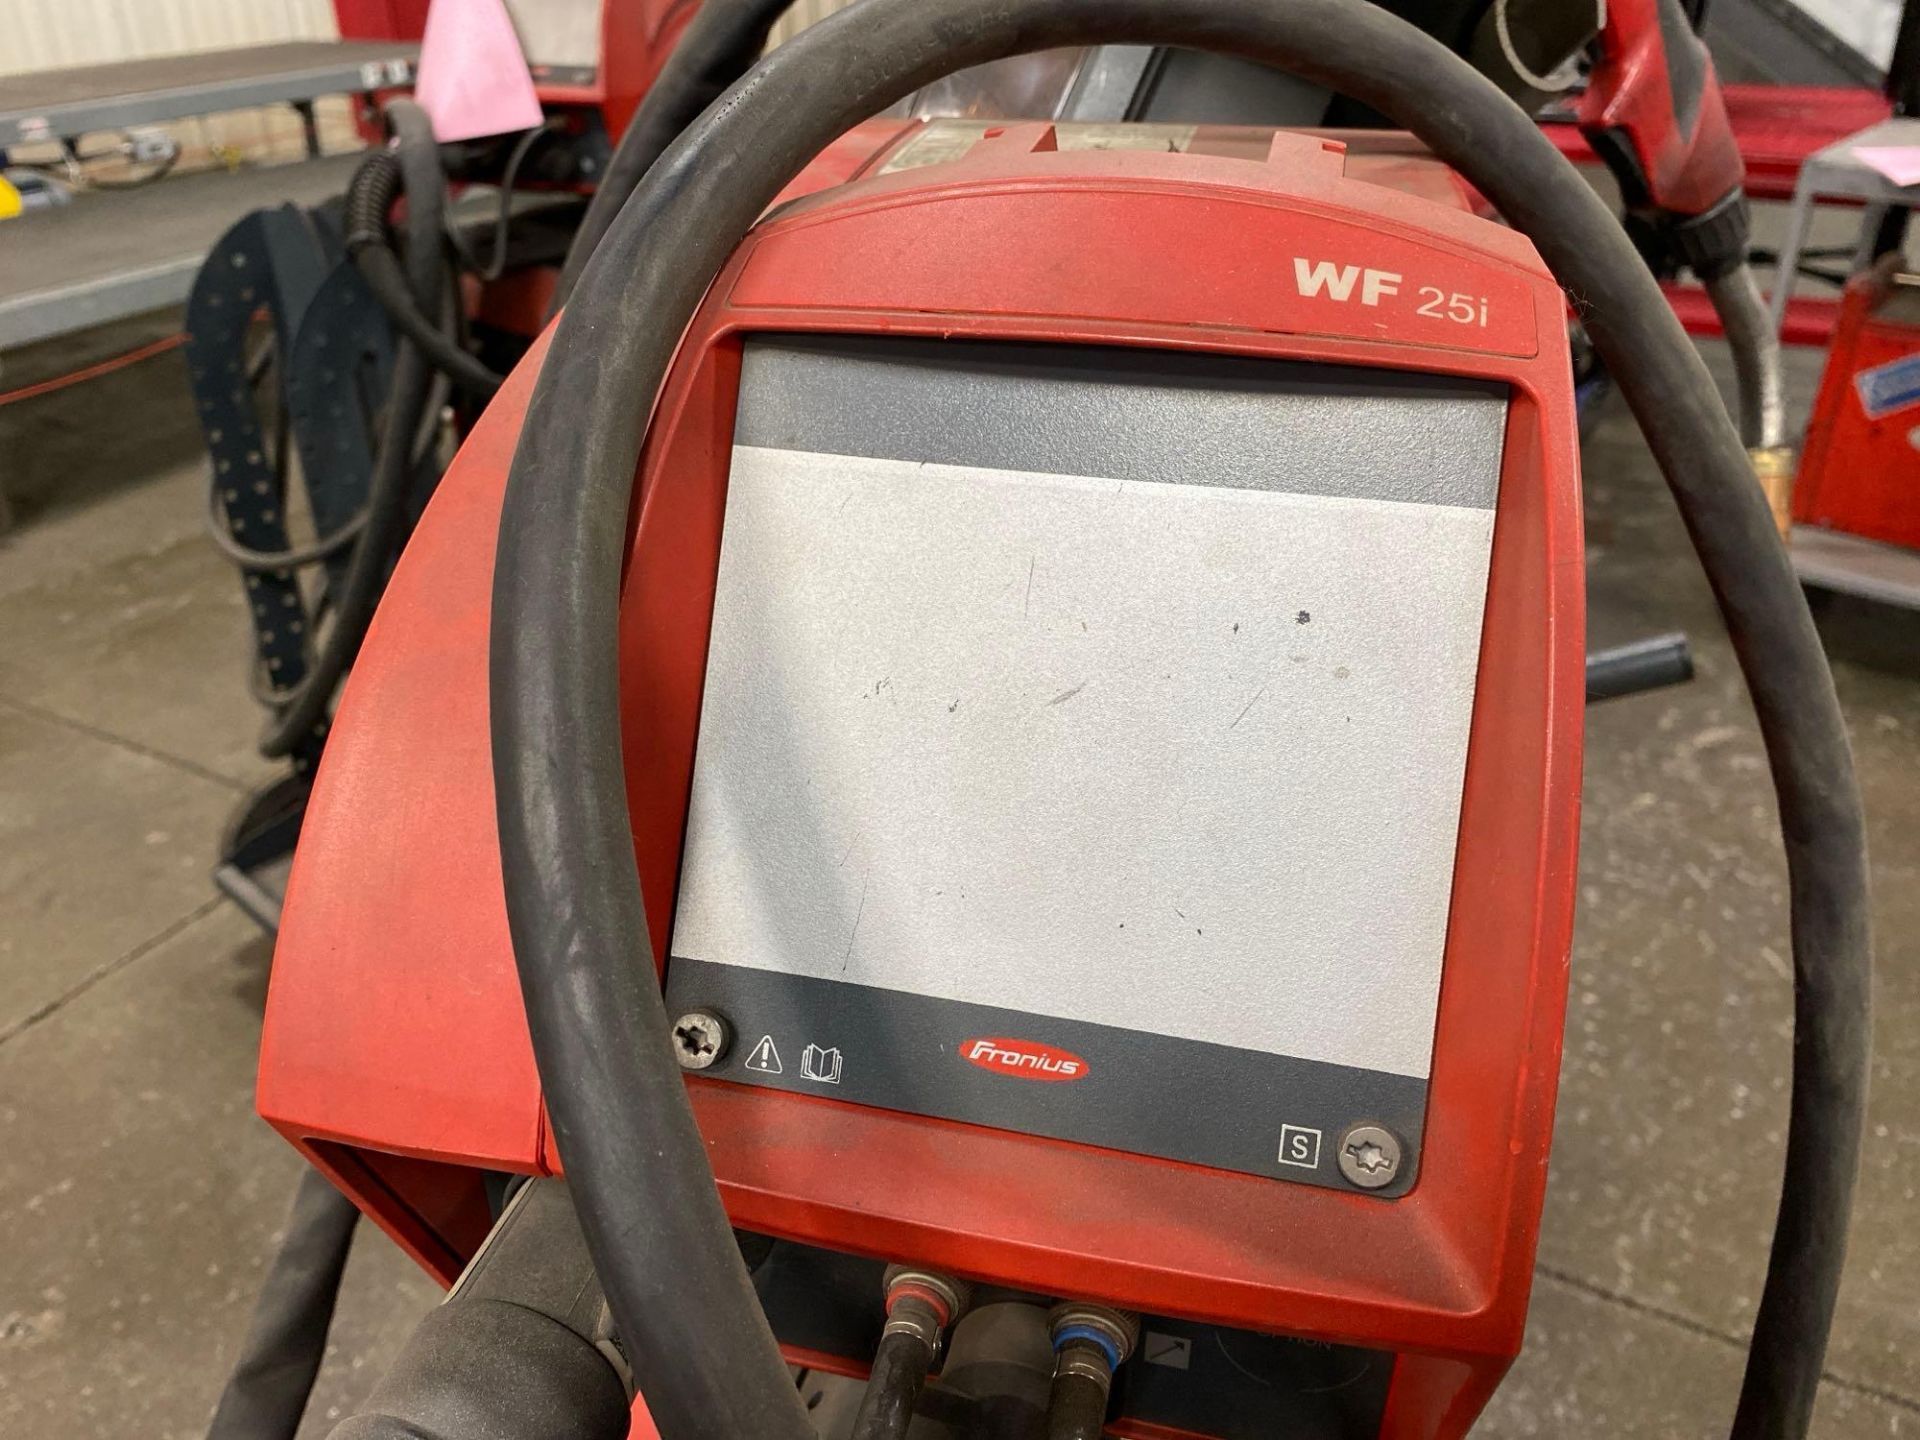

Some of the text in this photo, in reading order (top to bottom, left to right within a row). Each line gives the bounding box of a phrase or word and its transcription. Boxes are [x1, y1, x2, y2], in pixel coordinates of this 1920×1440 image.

[1293, 257, 1488, 327] WF 25i
[969, 1041, 1079, 1075] Fronius
[1291, 1135, 1308, 1159] S
